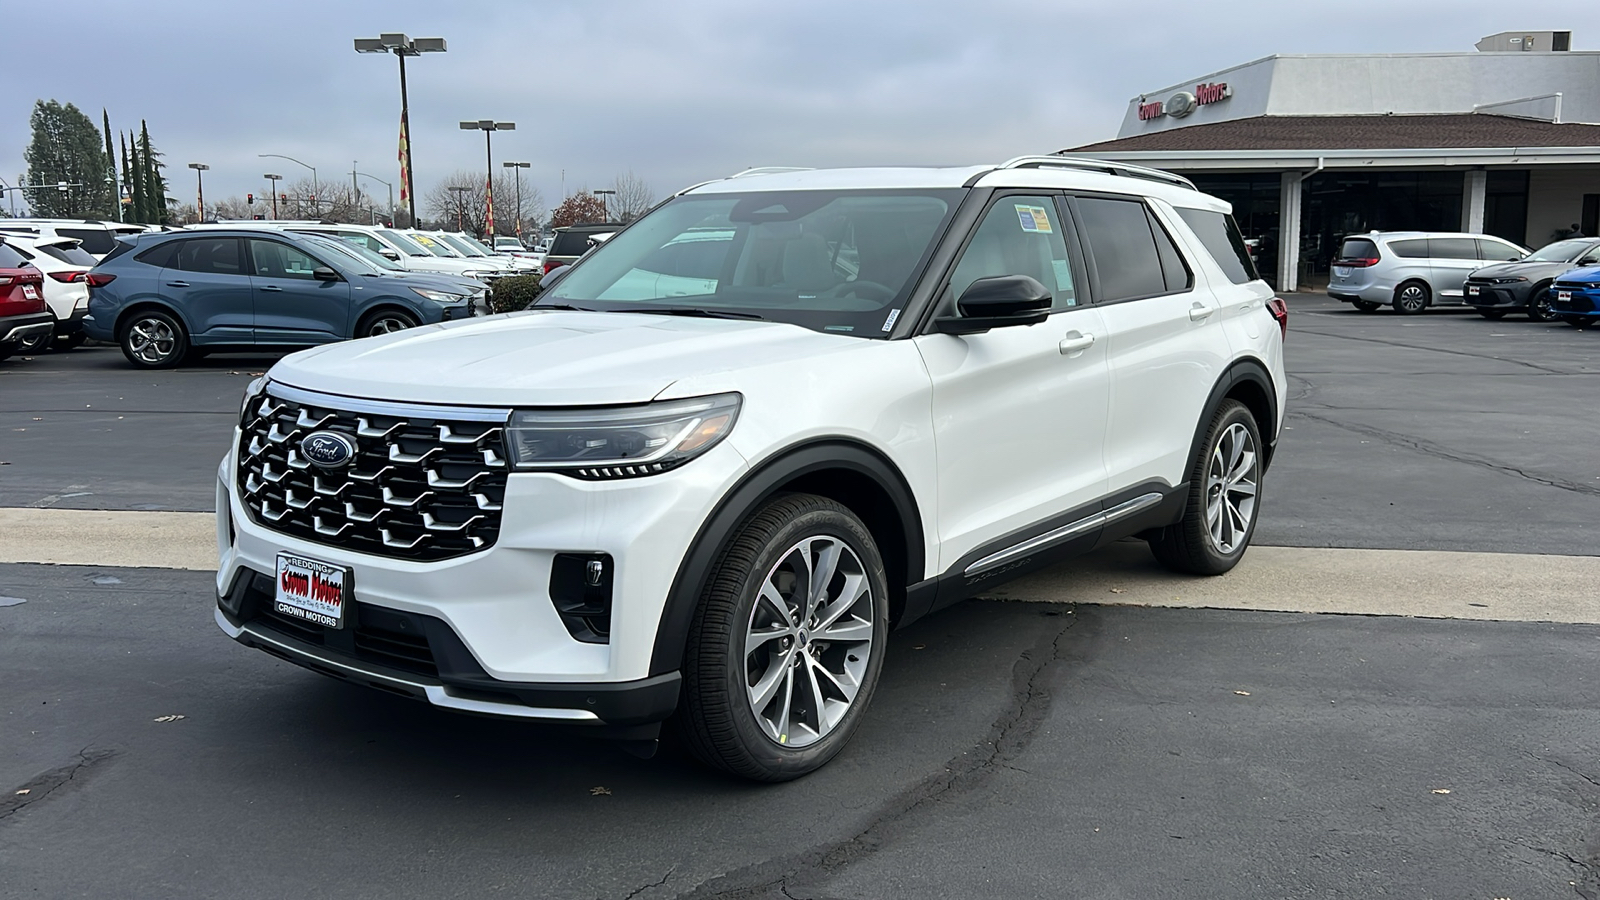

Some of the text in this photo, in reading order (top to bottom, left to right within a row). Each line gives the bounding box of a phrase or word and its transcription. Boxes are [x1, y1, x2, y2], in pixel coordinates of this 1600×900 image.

[1138, 101, 1162, 120] Crown
[1196, 83, 1227, 106] Motors
[309, 438, 338, 460] Ford
[292, 559, 327, 572] REDDING
[282, 570, 342, 607] Crown Motors
[278, 603, 337, 626] CROWN MOTORS
